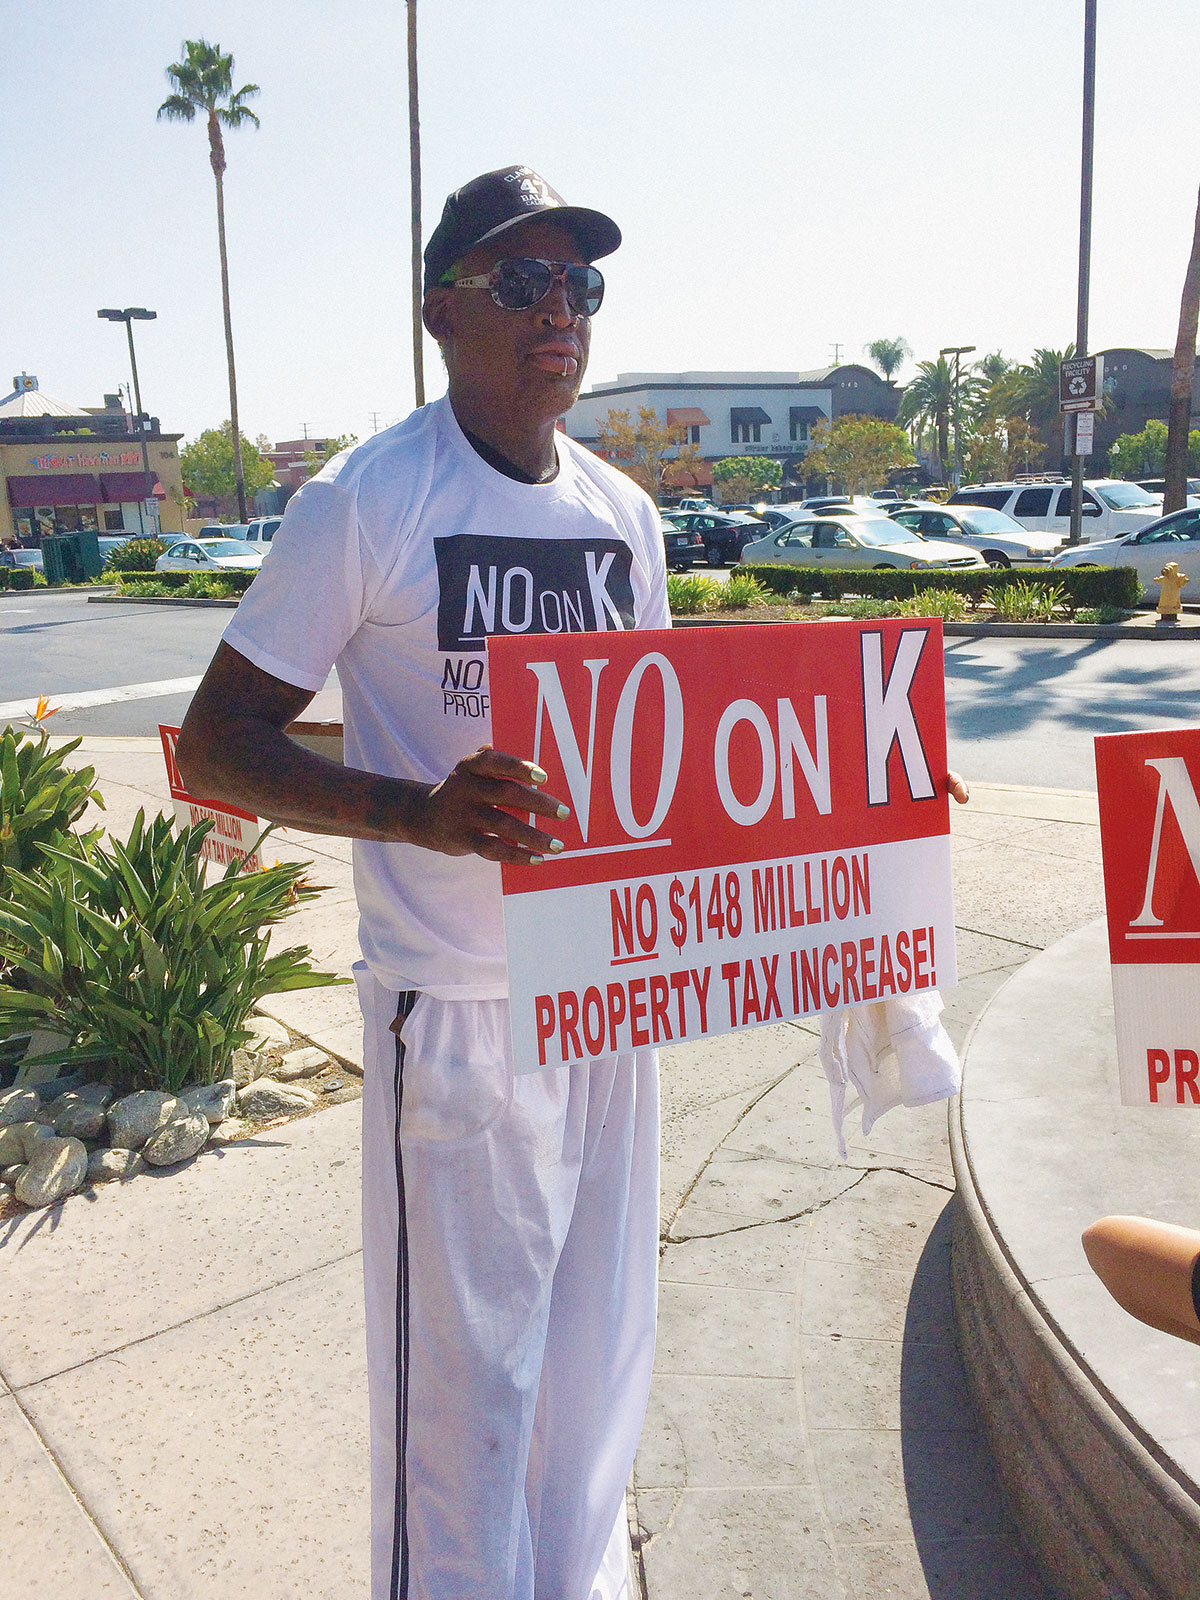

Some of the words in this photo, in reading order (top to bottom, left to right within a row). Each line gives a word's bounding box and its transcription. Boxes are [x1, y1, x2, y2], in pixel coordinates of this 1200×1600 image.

[1062, 360, 1094, 371] RECYCLING
[1065, 368, 1091, 377] FACILITY
[463, 564, 534, 634] NO
[539, 590, 586, 634] ON
[584, 551, 625, 632] K
[441, 658, 485, 691] NO
[517, 651, 685, 849] NO
[714, 694, 833, 827] ON
[860, 627, 938, 808] K
[216, 812, 243, 842] MILLION
[610, 883, 659, 957] NO
[669, 871, 743, 956] $148
[752, 853, 871, 934] MILLION
[535, 966, 712, 1067] PROPERTY
[721, 954, 784, 1028] TAX
[791, 926, 937, 1015] INCREASE!
